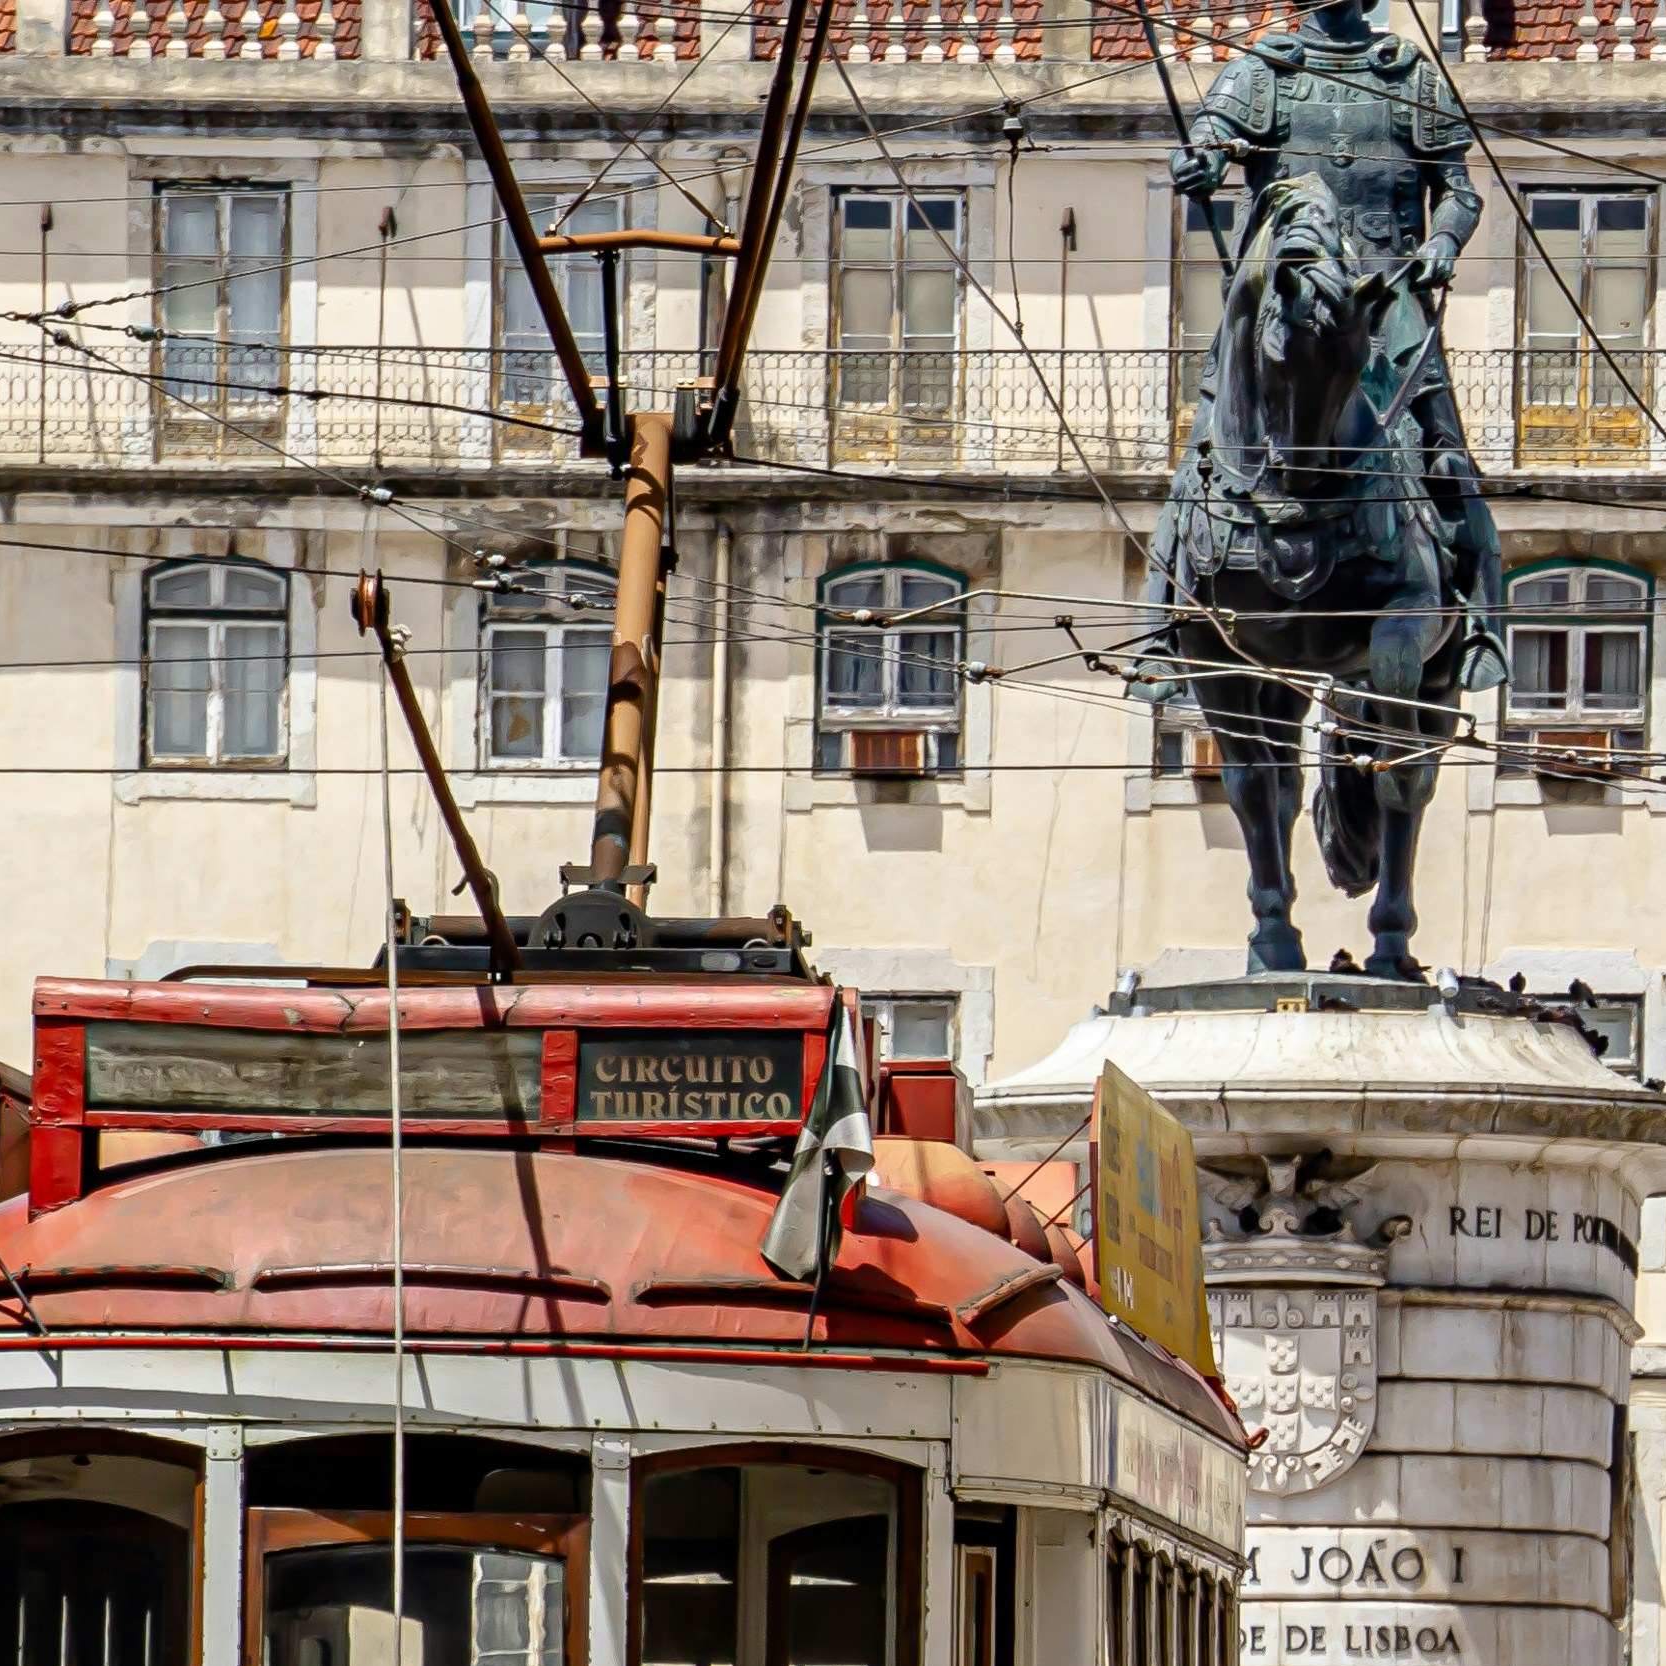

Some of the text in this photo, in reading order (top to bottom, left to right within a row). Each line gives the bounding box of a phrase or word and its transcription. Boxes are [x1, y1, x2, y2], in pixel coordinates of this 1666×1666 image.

[595, 1055, 774, 1084] CIRCUITO
[590, 1085, 792, 1120] TURÍSTICO
[1449, 1206, 1502, 1239] REI
[1525, 1209, 1559, 1242] DE
[1291, 1539, 1425, 1584] JOÃO
[1453, 1547, 1465, 1584] I
[1286, 1625, 1326, 1652] DE
[1345, 1625, 1462, 1654] LISBOA
